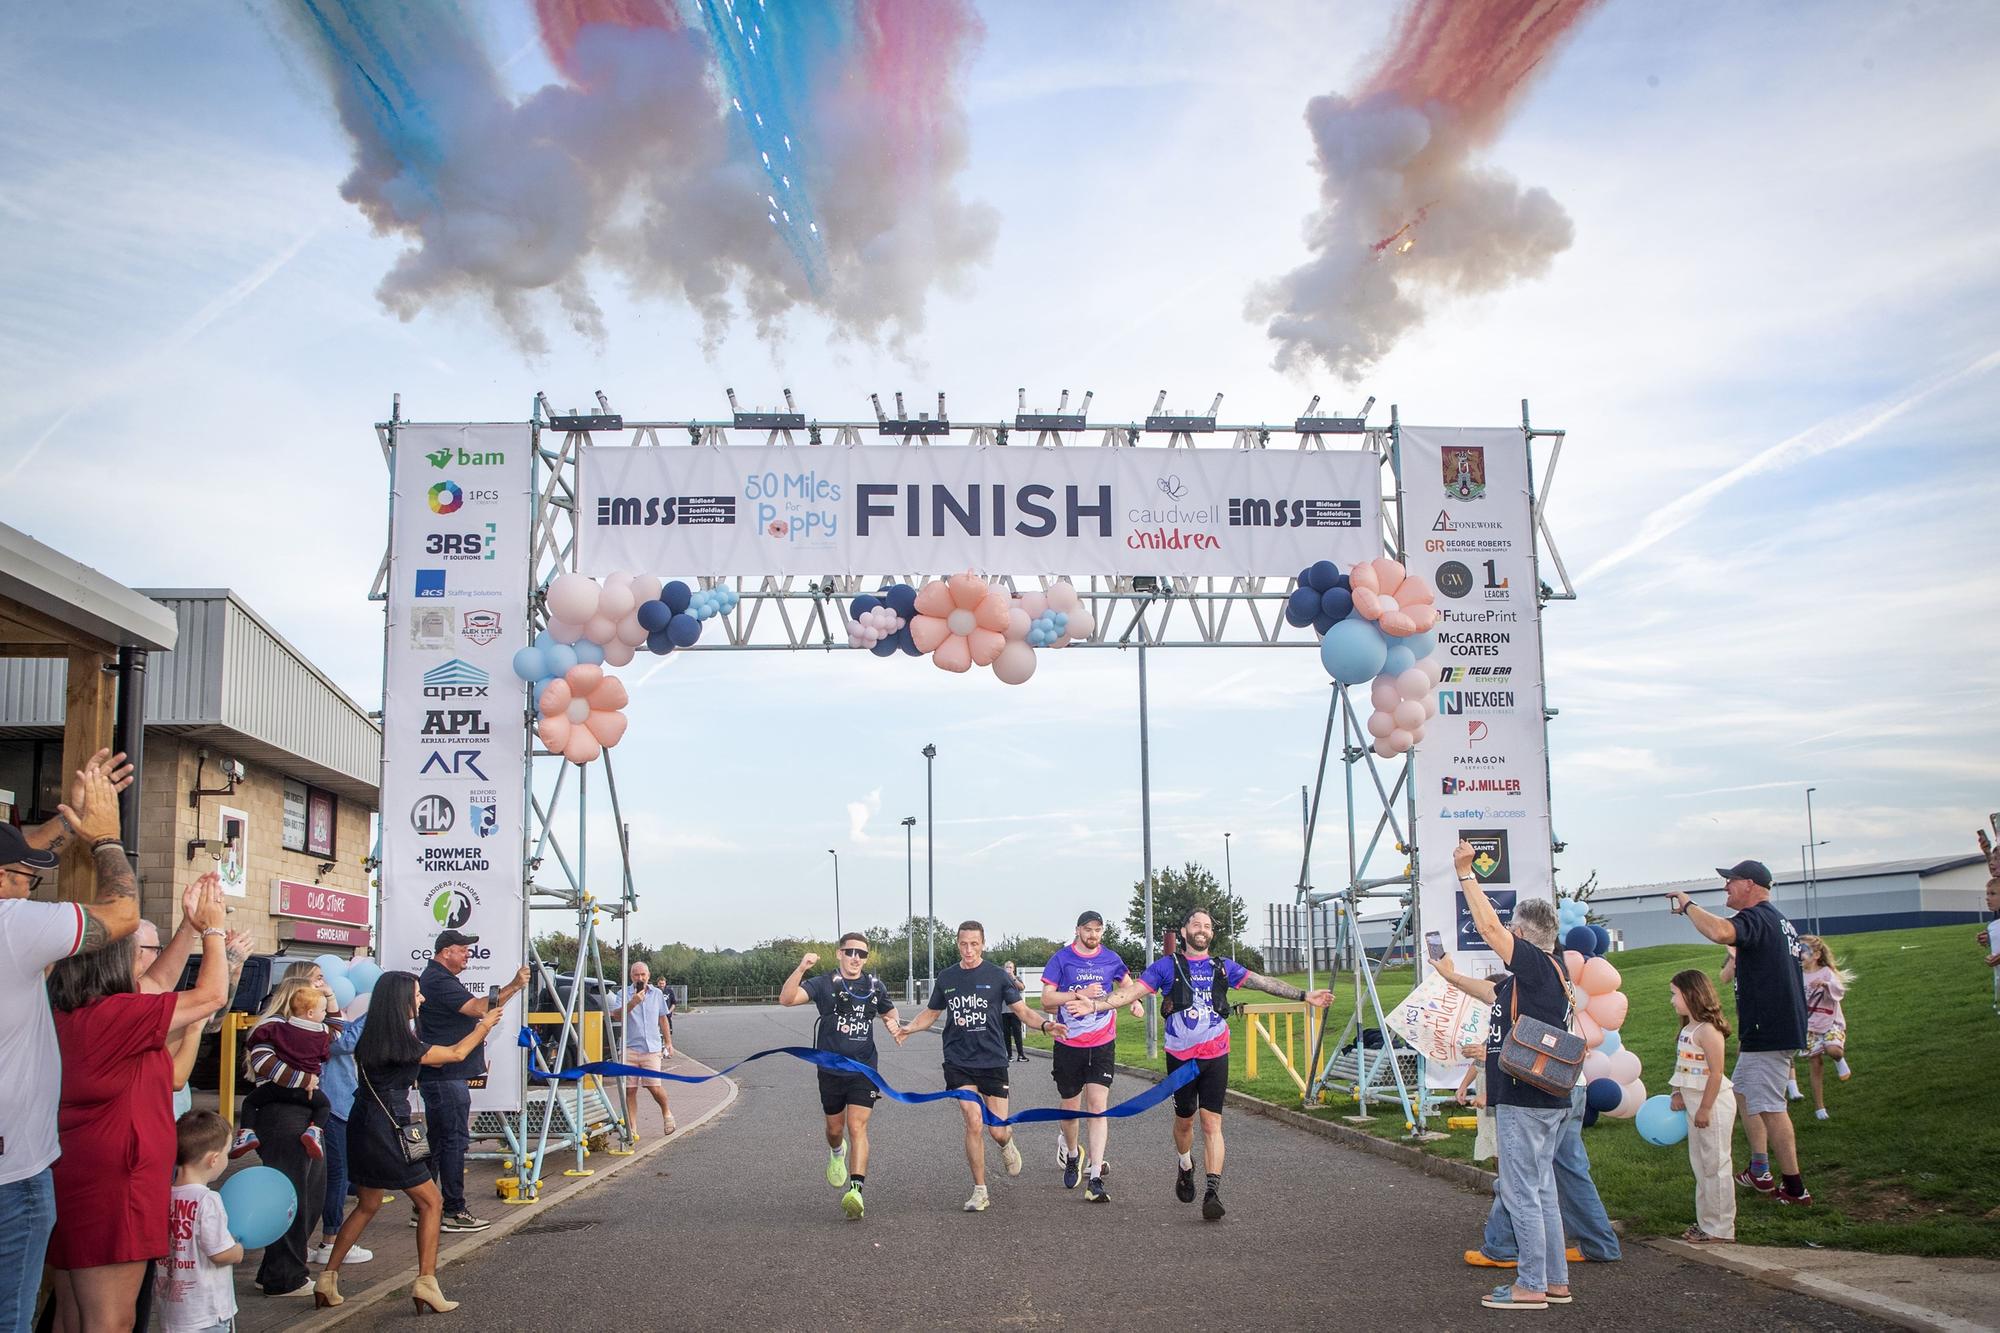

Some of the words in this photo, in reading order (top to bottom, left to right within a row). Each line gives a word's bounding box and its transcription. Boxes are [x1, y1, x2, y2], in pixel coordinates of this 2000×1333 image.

[458, 447, 505, 466] bam
[744, 471, 779, 500] 50
[783, 470, 841, 503] Miles
[469, 490, 499, 500] 1PCS
[608, 497, 677, 526] MSS
[689, 507, 725, 515] Scaffolding
[785, 501, 802, 511] for
[856, 483, 1112, 538] FINISH
[1240, 498, 1304, 527] MSS
[1128, 505, 1220, 524] caudwell
[1316, 511, 1351, 519] Scaffolding
[758, 502, 837, 542] Poppy
[1448, 521, 1503, 529] STONEWORK
[426, 534, 482, 555] 3RS
[1127, 527, 1222, 550] children
[1425, 539, 1445, 552] GR
[421, 589, 444, 597] acs
[448, 590, 472, 598] Staffing
[1443, 609, 1518, 622] FuturePrint
[1438, 632, 1510, 644] McCARRON
[1450, 645, 1499, 656] COATES
[1468, 666, 1492, 675] NEW
[1492, 666, 1513, 675] ERA
[1475, 676, 1510, 684] Energy
[423, 686, 489, 701] apex
[1465, 691, 1515, 708] NEXGEN
[421, 709, 490, 735] APL
[1453, 755, 1506, 764] PARAGON
[1458, 779, 1521, 792] P.J.MILLER
[425, 848, 482, 859] BOWMER
[425, 860, 490, 872] KIRKLAND
[424, 880, 452, 907] BRADDERS
[457, 881, 481, 906] ACADEMY
[307, 891, 325, 910] CLUB
[948, 996, 961, 1011] 50
[961, 993, 988, 1009] Miles
